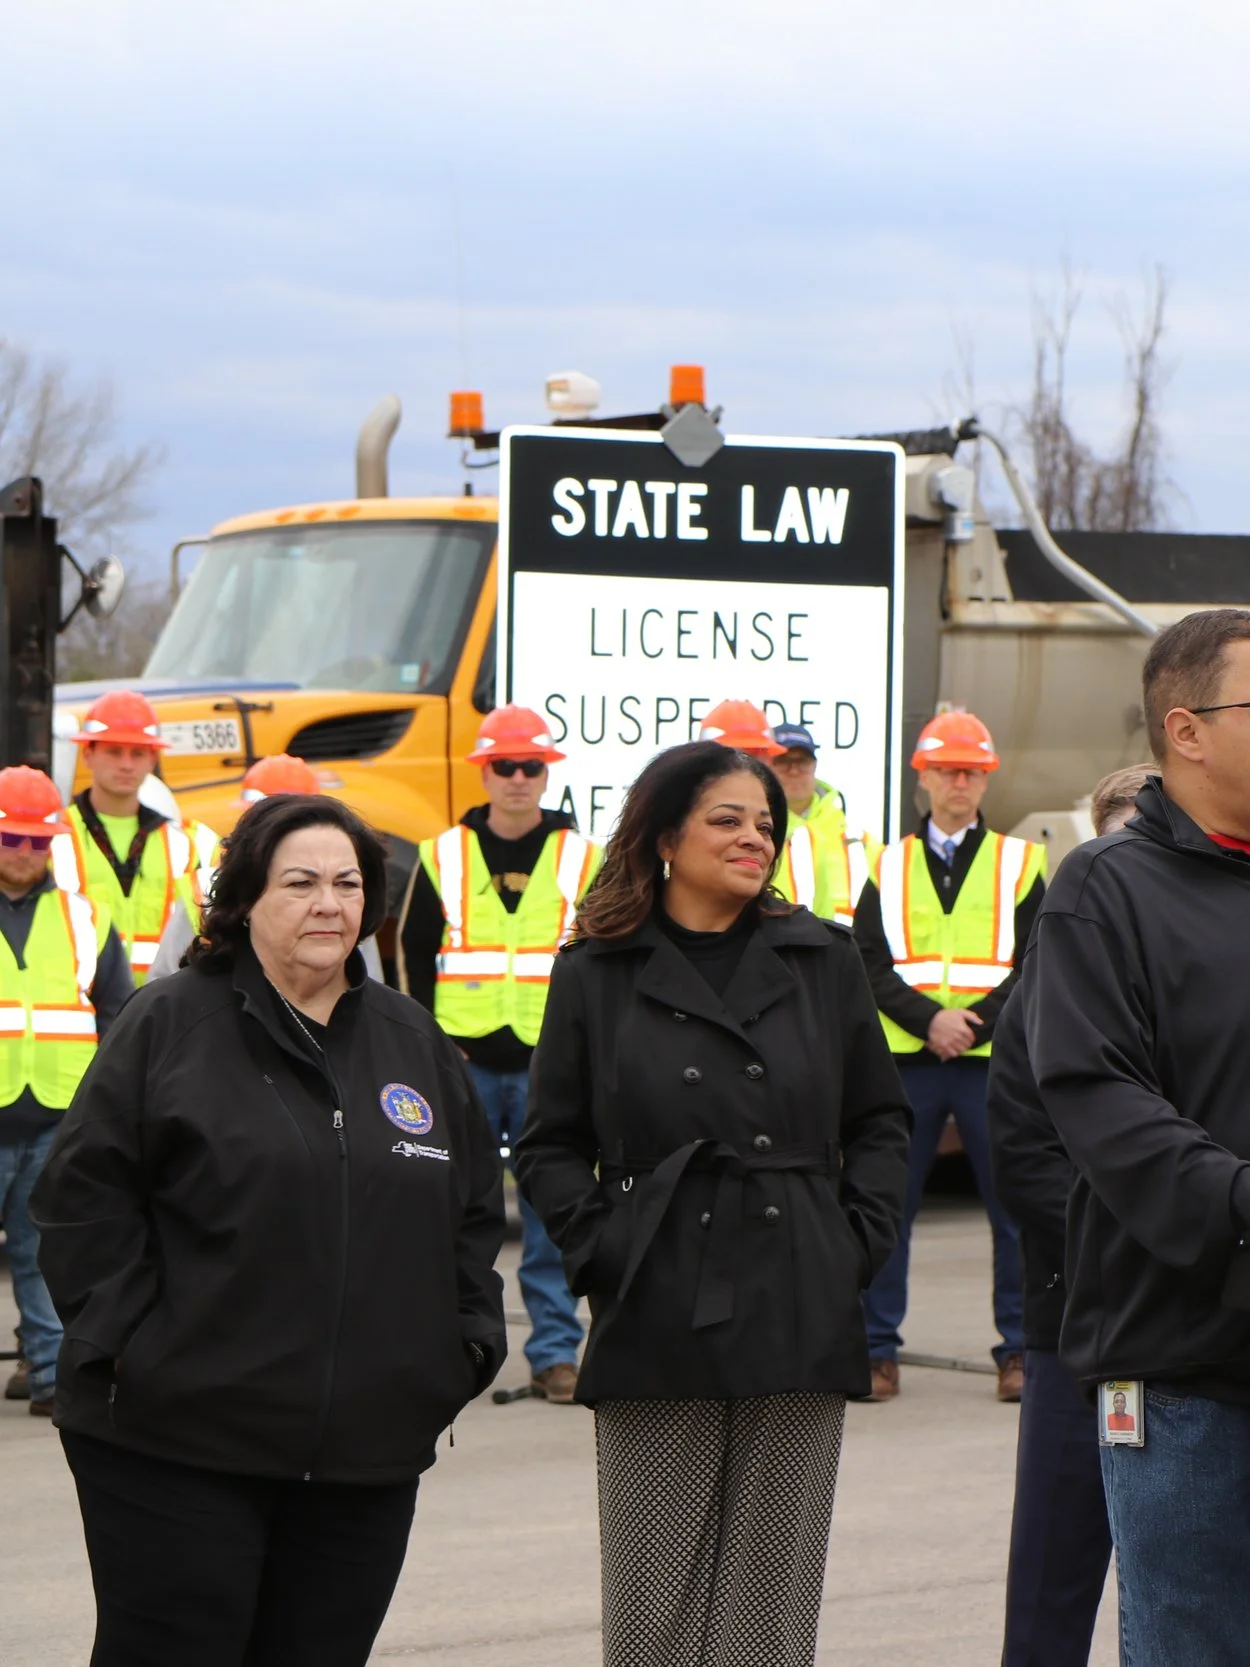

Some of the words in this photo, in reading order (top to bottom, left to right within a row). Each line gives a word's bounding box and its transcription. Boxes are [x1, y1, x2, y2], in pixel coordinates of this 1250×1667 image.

[551, 477, 708, 540] STATE
[741, 484, 849, 544] LAW
[591, 608, 808, 661] LICENSE
[193, 722, 237, 750] 5366
[545, 694, 859, 750] SUSPEDED
